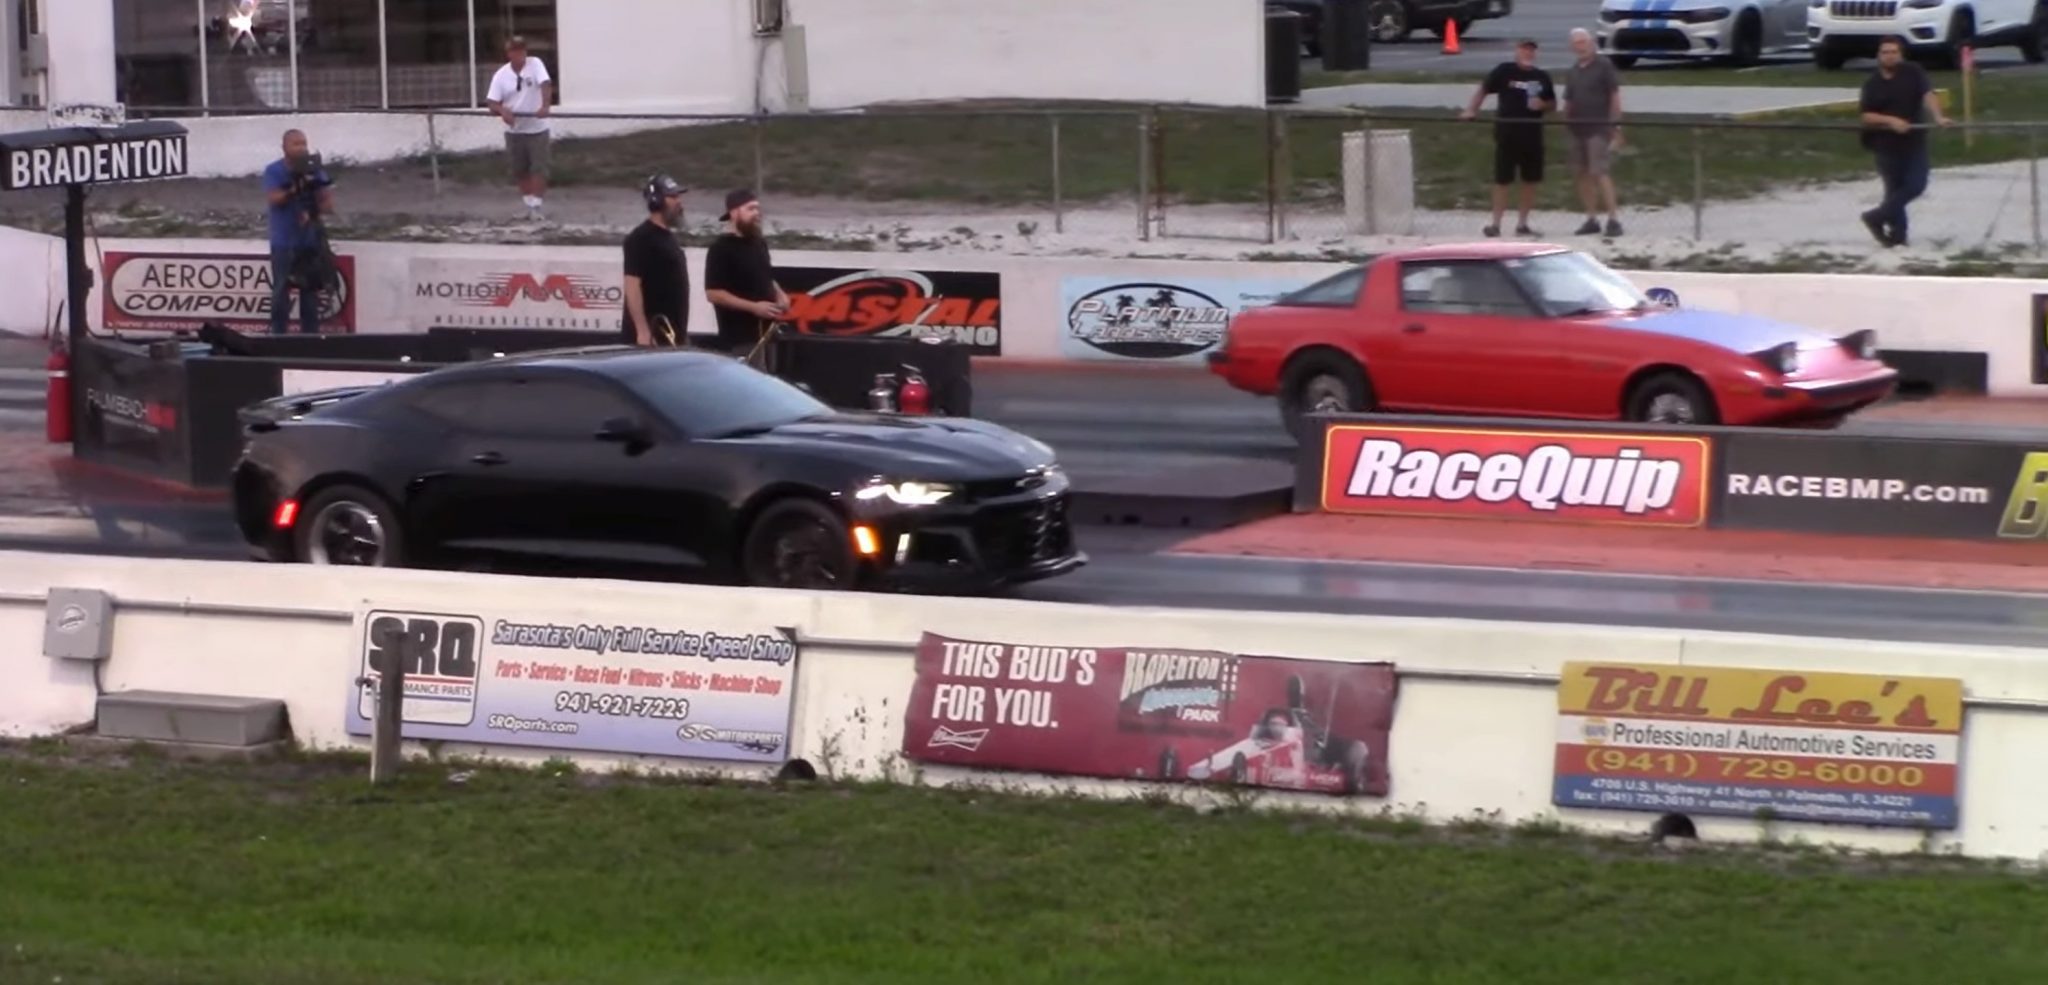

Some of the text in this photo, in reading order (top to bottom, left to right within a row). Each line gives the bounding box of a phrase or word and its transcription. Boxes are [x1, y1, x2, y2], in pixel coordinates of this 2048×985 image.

[11, 137, 183, 189] BRADENTON
[142, 264, 273, 290] AEROSPA
[416, 282, 510, 300] MOTION
[1347, 438, 1681, 514] RaceQuip
[1728, 474, 1989, 503] RACEBMP.com
[492, 619, 793, 665] Sarasota's Only Full Service Speed Shop
[495, 659, 522, 678] Parts
[528, 662, 567, 681] Service
[574, 665, 600, 684] Race
[600, 667, 623, 685] Fuel
[709, 673, 753, 693] Machine
[755, 676, 782, 696] Shop
[940, 641, 1096, 686] THIS BUD'S
[1120, 651, 1221, 702] BRADENTON
[442, 684, 472, 697] PARTS
[555, 691, 689, 720] 941-921-7223
[931, 685, 1058, 729] FOR YOU.
[1584, 666, 1938, 727] Bill Lee's
[487, 714, 578, 735] SRQparts.com
[1181, 708, 1220, 723] PARK
[1613, 722, 1731, 749] Professional
[1736, 730, 1845, 755] Automotive
[1851, 735, 1936, 759] Services
[1585, 749, 1924, 787] (941) 729-6000
[1625, 780, 1650, 791] U.S.
[1654, 783, 1711, 797] Highway
[1715, 786, 1730, 795] 41
[1852, 793, 1870, 804] FL
